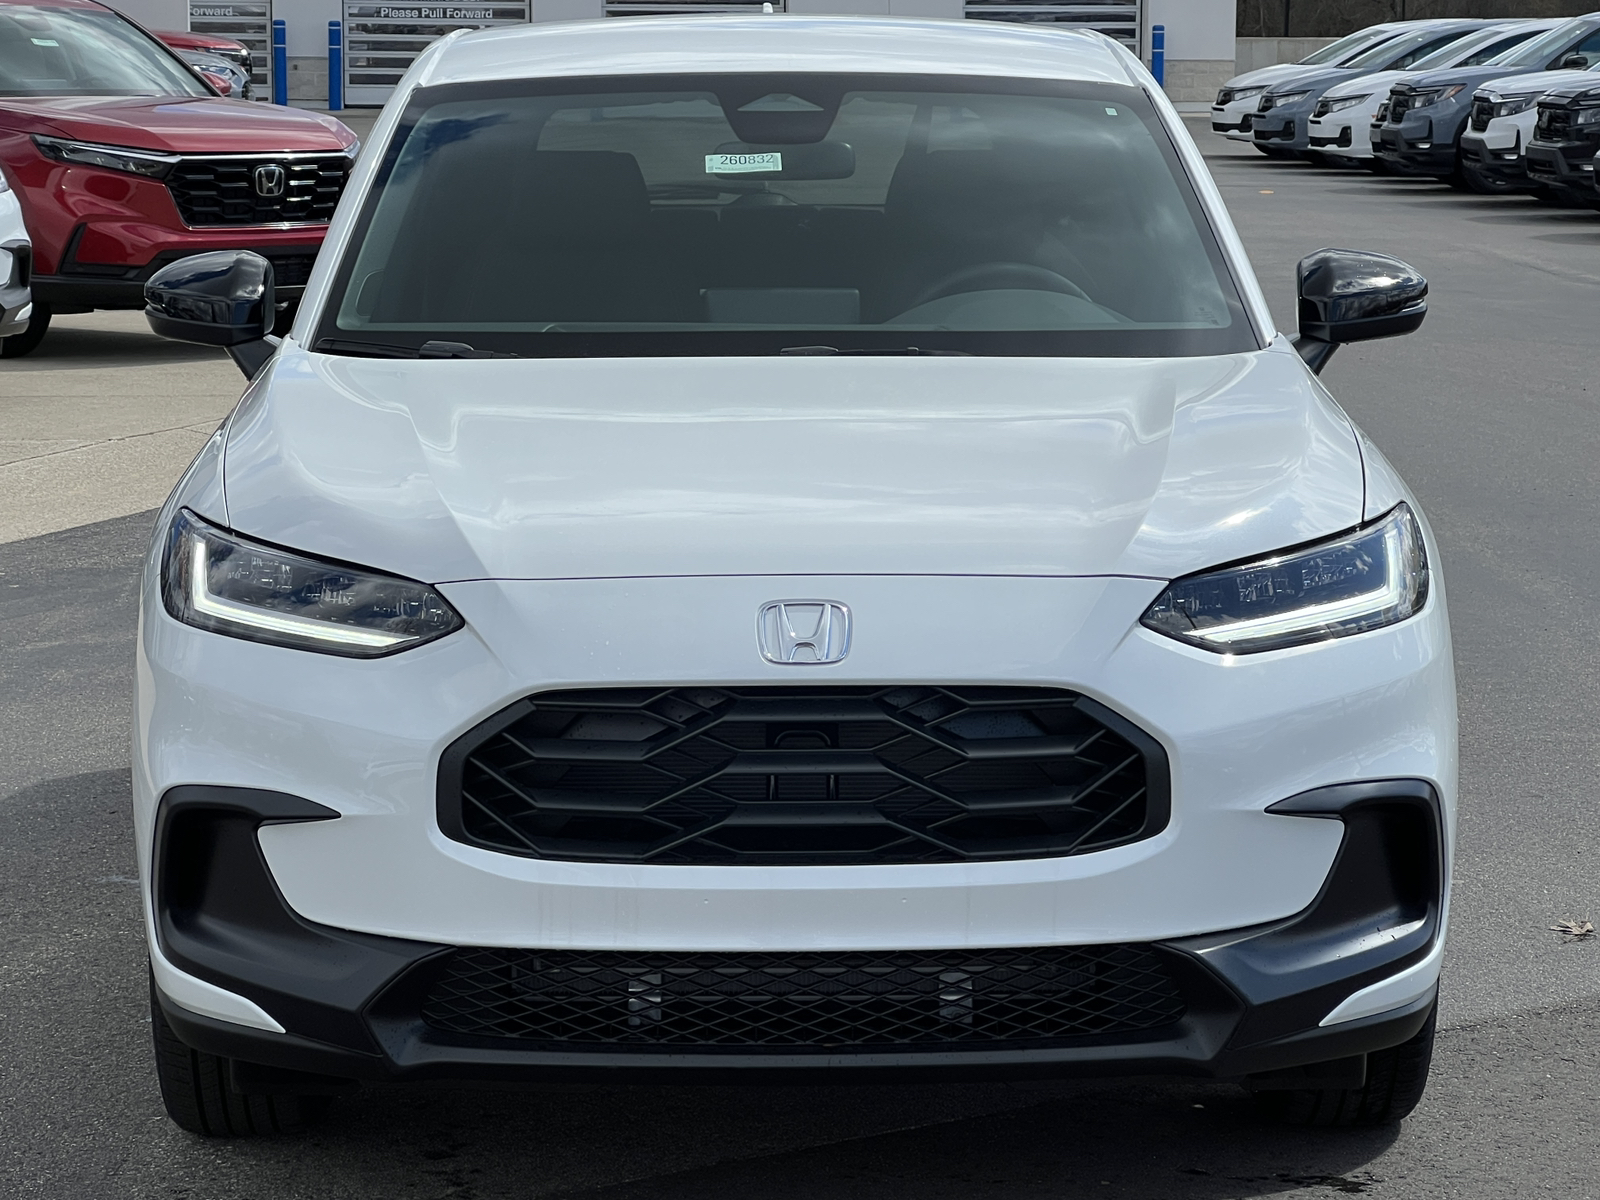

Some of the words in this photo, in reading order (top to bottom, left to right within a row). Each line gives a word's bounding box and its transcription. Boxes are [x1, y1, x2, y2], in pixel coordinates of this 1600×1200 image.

[380, 7, 419, 18] Please
[421, 8, 443, 18] Pull
[446, 8, 493, 19] Forward
[720, 154, 774, 165] 260832
